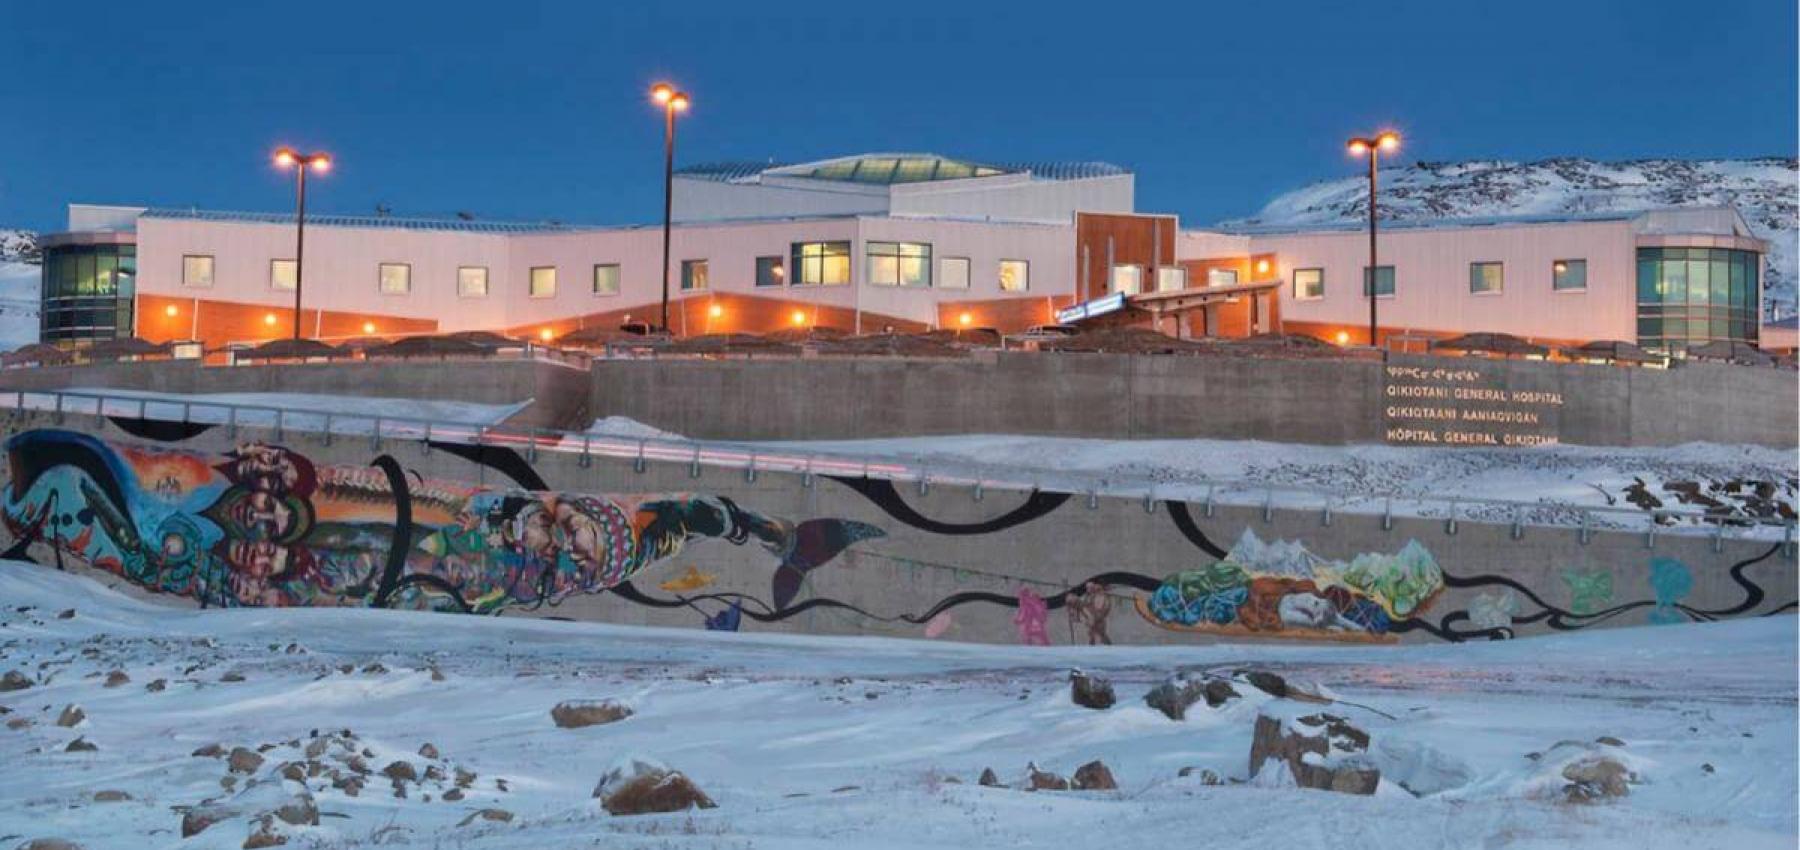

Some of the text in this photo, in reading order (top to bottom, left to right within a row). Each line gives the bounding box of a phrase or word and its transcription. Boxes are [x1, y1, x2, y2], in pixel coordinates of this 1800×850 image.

[1455, 388, 1506, 401] GENERAL
[1512, 391, 1563, 404] HOSPITAL
[1387, 428, 1437, 441] HÔPITAL
